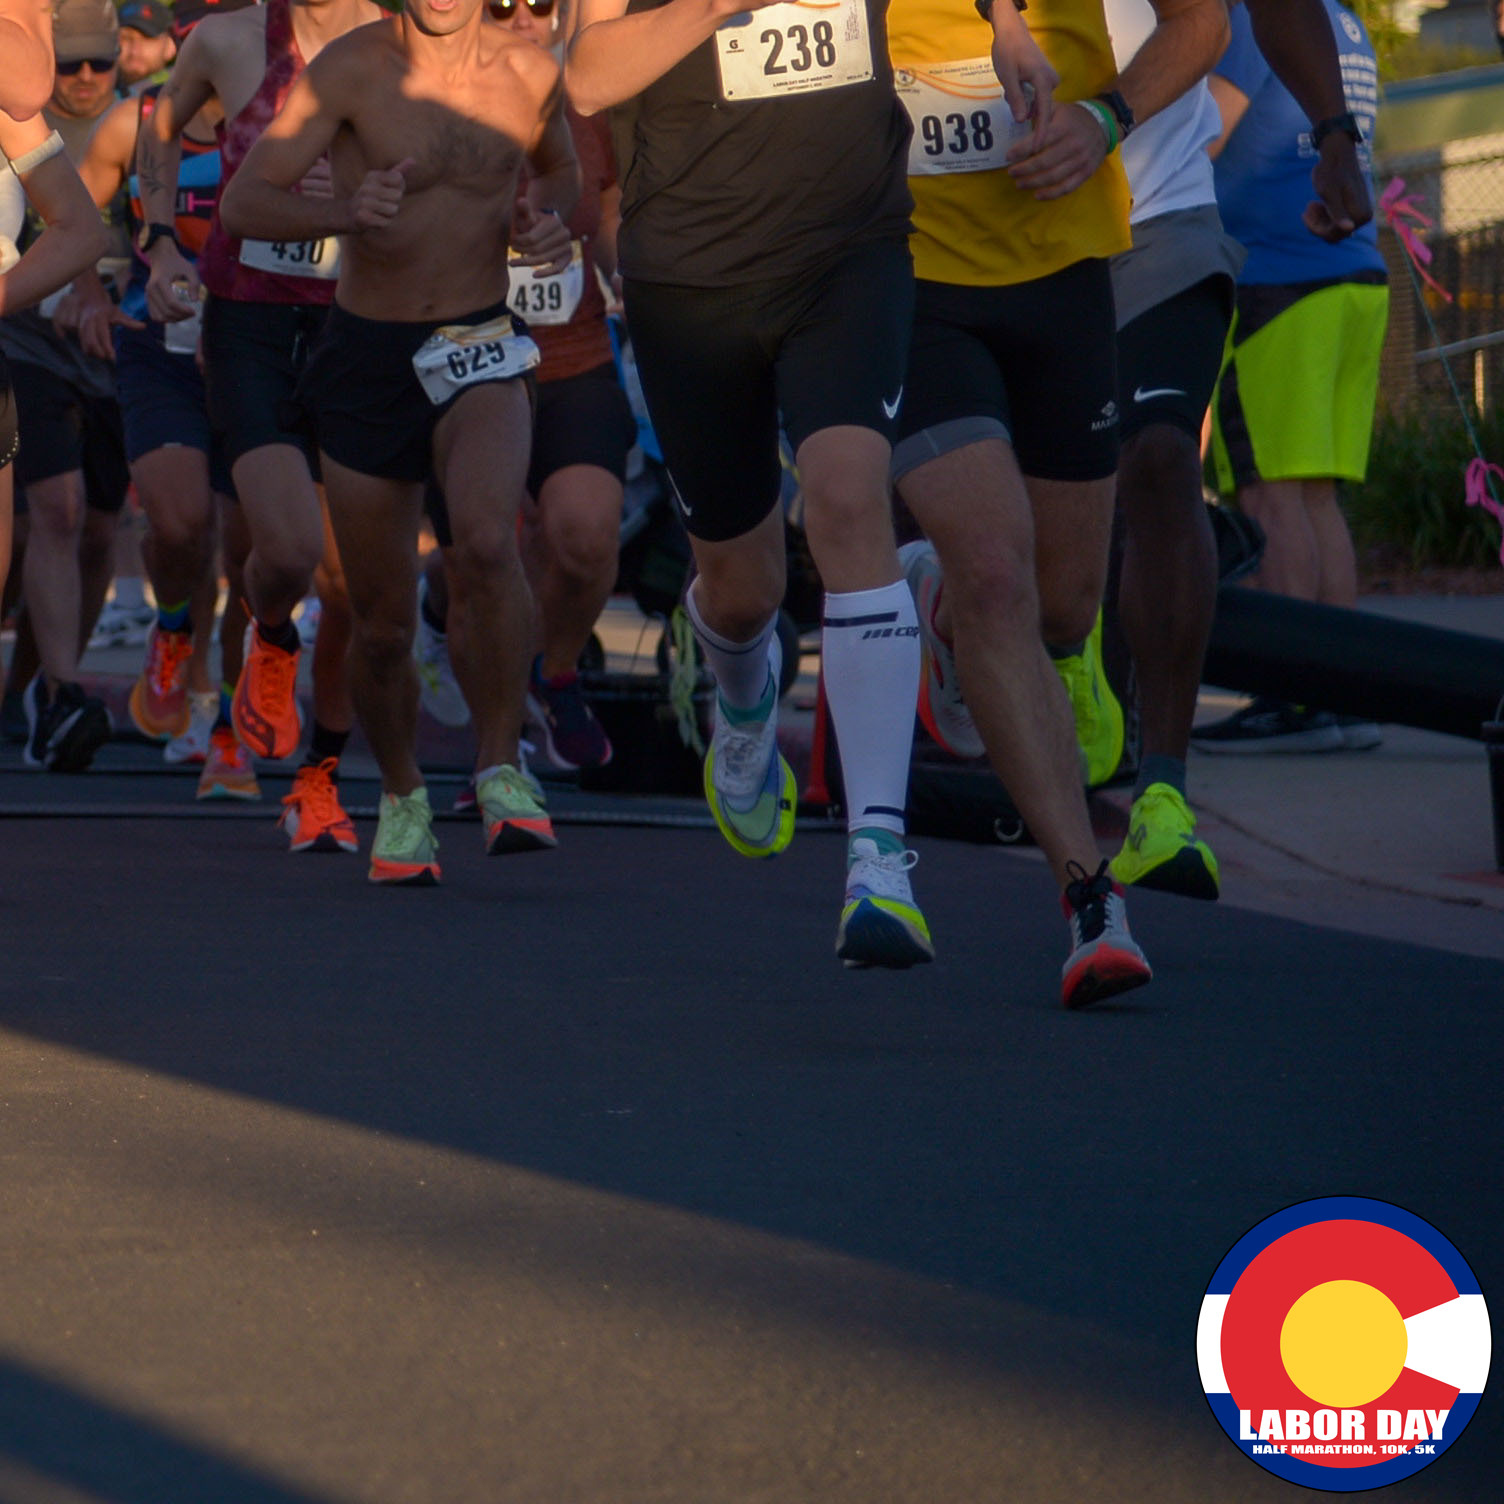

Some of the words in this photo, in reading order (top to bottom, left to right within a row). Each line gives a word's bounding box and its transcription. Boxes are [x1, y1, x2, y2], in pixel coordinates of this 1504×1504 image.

[760, 20, 837, 76] 238
[921, 109, 994, 156] 938
[271, 240, 326, 264] 430
[514, 281, 562, 313] 439
[446, 341, 506, 379] 629
